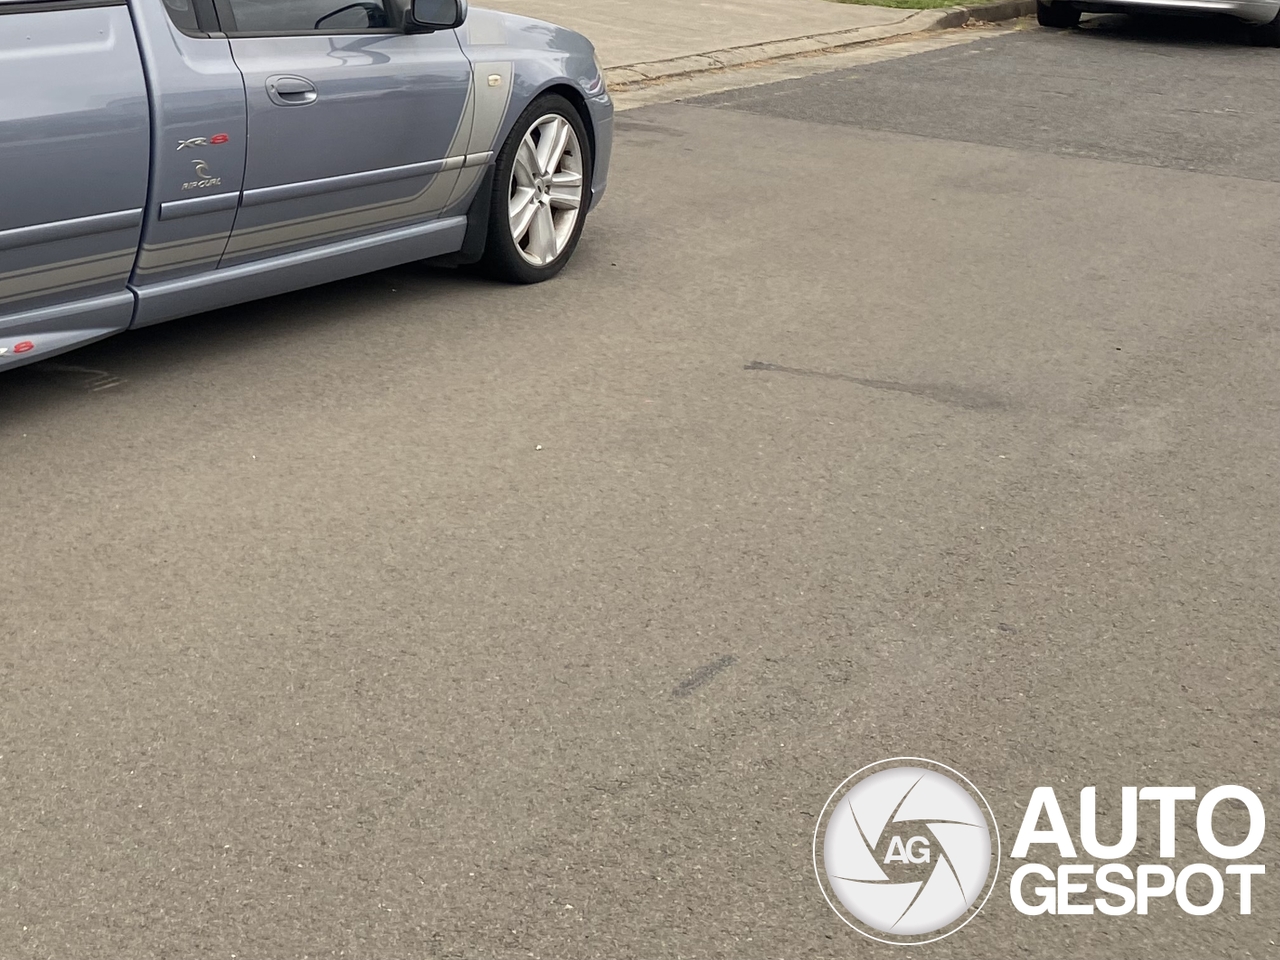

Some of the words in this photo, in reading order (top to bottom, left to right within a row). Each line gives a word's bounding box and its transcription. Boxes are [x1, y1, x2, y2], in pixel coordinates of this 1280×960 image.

[176, 132, 230, 152] XR8
[181, 181, 200, 191] RIP
[198, 177, 222, 189] CURL
